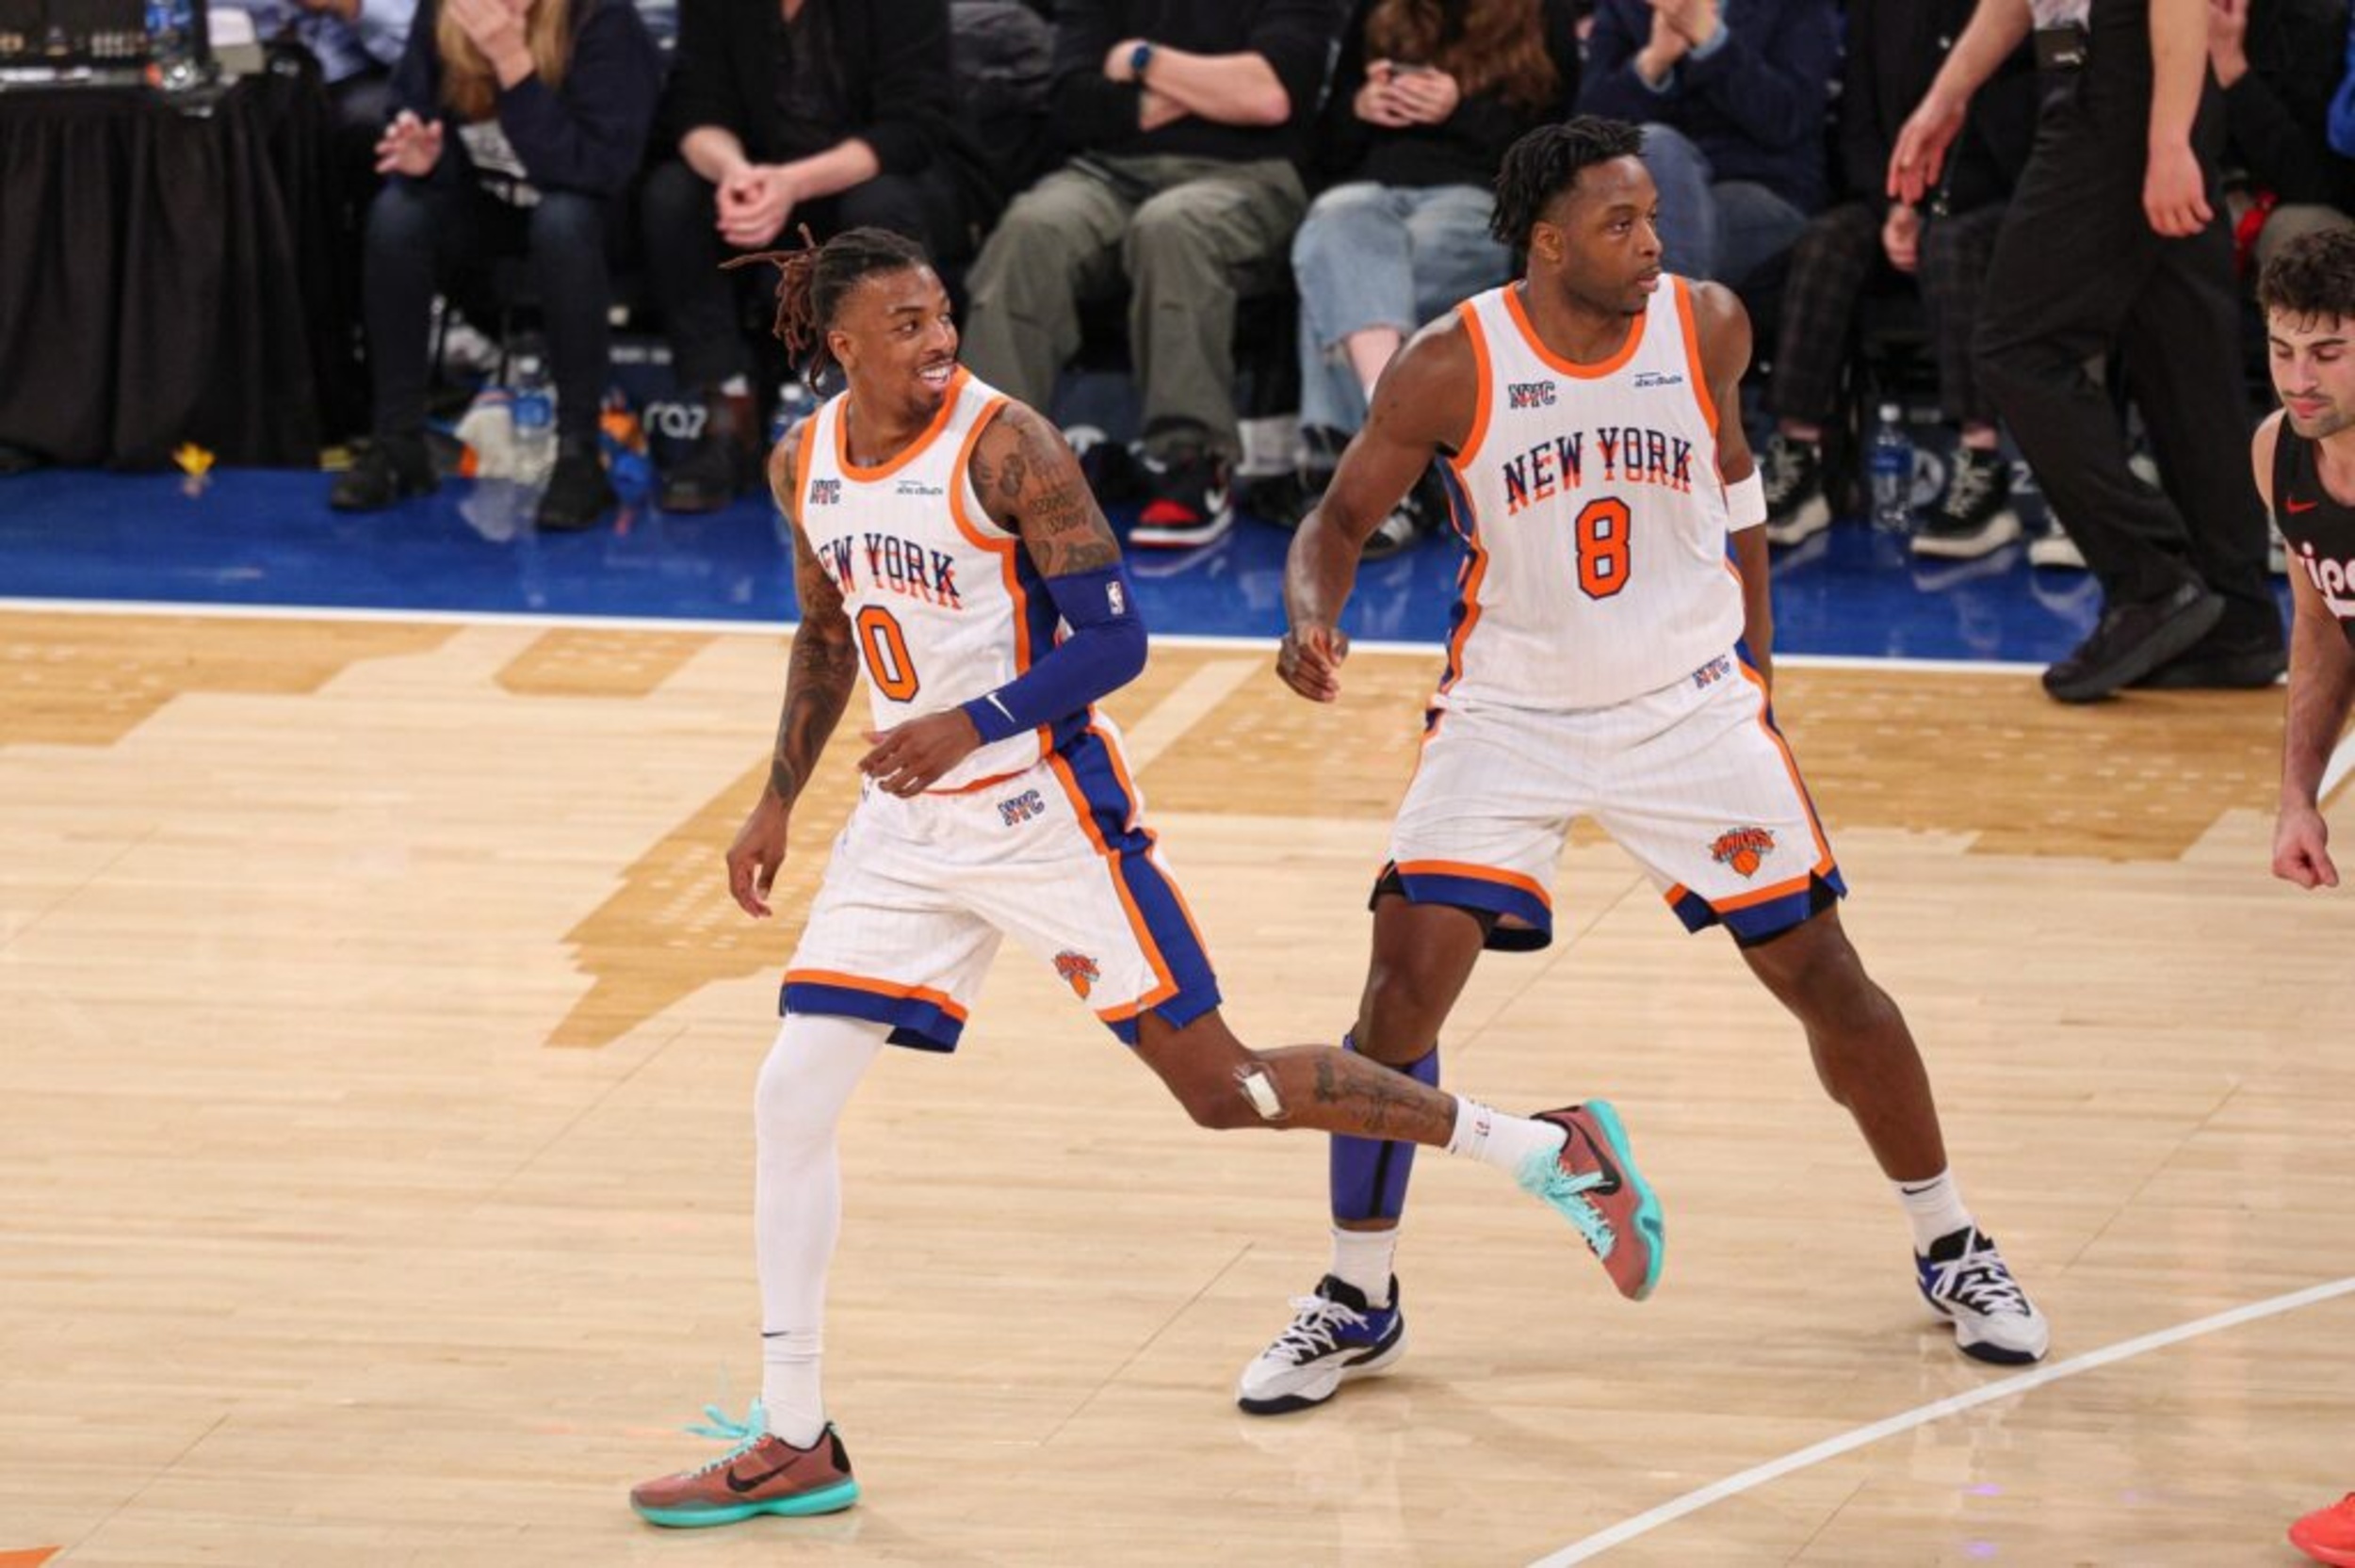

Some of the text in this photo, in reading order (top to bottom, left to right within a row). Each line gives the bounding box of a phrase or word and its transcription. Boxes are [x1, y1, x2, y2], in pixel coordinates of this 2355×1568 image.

[1507, 380, 1556, 409] NYC
[1502, 427, 1692, 515] NEW YORK
[818, 532, 963, 610] EW YORK
[1574, 495, 1632, 601] 8
[854, 604, 921, 704] 0
